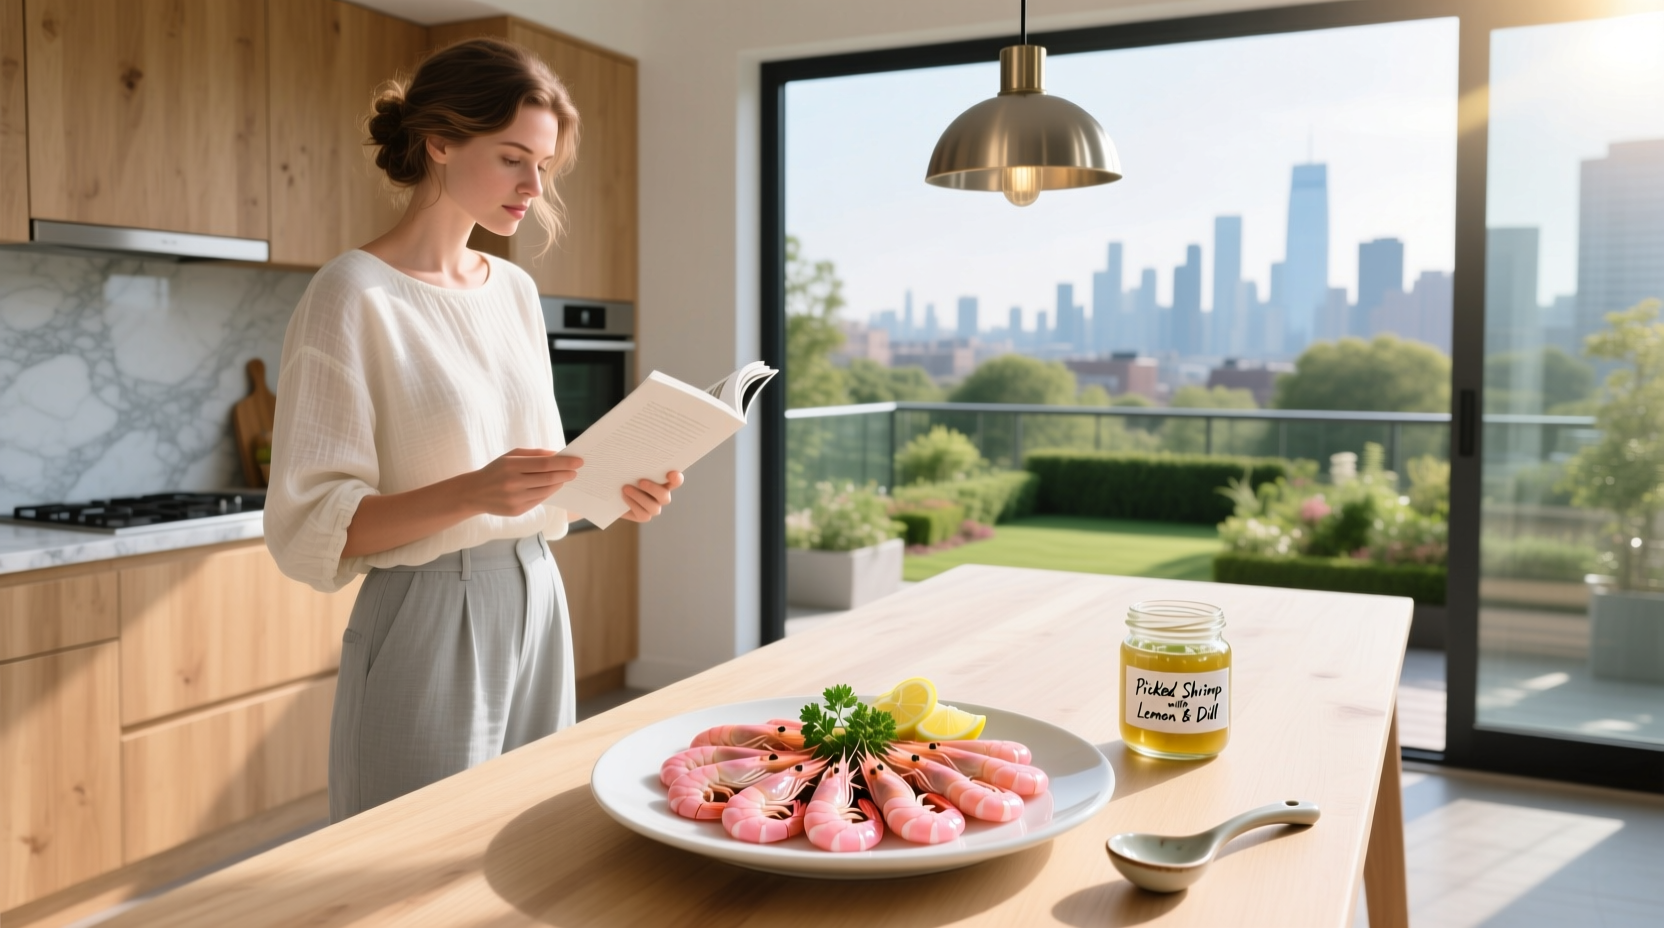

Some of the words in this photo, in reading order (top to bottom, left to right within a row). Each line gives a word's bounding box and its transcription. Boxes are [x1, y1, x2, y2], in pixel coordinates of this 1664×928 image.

[1136, 678, 1177, 697] Picked
[1137, 702, 1176, 722] Lemon
[1182, 709, 1191, 722] &
[1197, 703, 1219, 723] Dill
